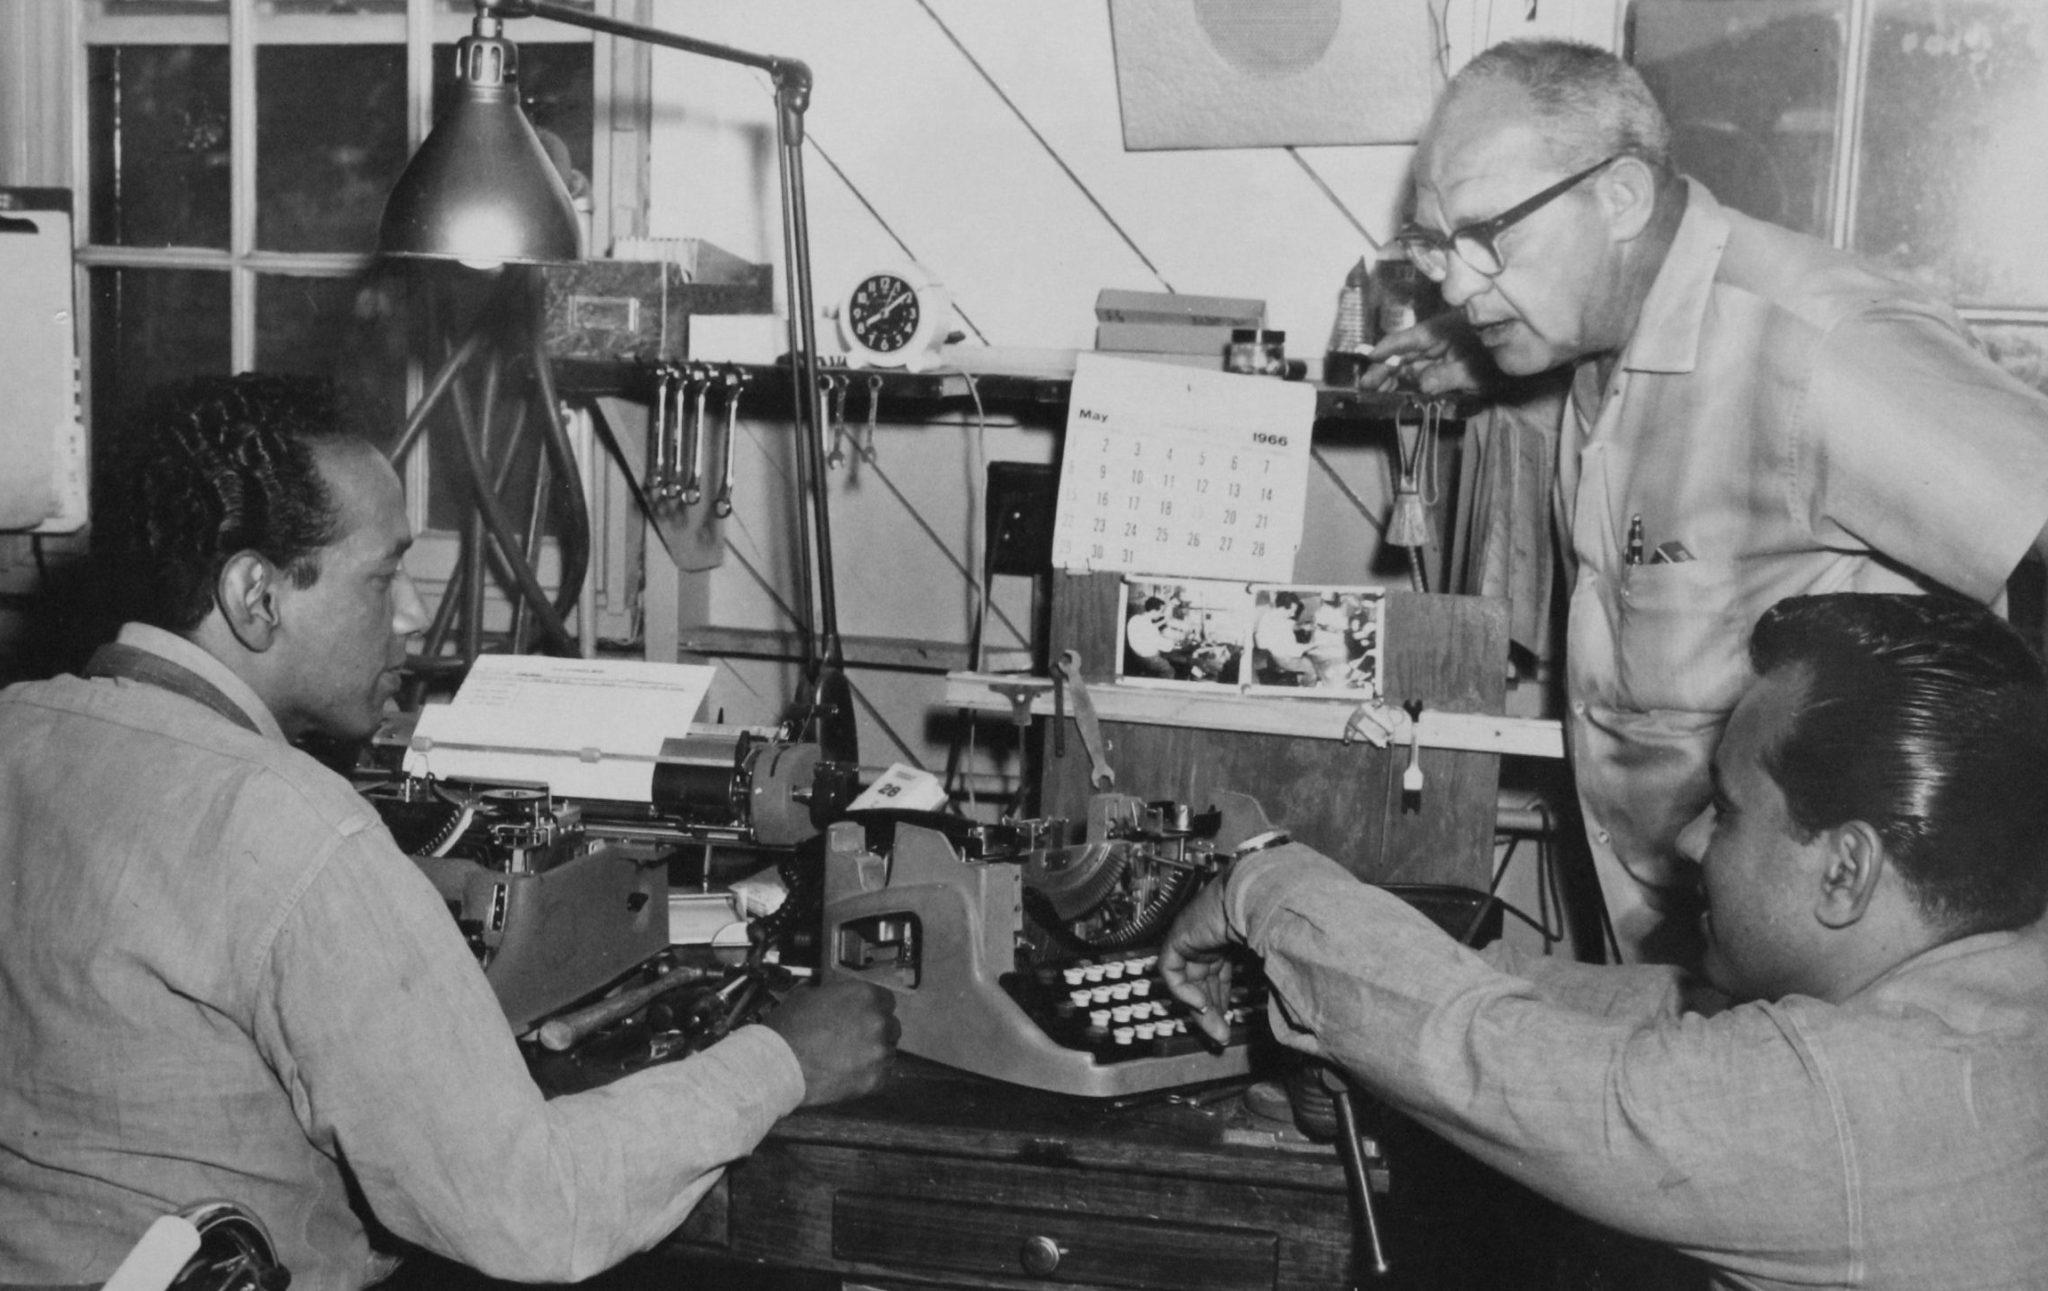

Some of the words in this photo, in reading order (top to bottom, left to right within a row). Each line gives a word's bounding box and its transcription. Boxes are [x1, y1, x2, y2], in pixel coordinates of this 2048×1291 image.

[868, 281, 876, 292] 11
[880, 277, 890, 288] 12
[857, 292, 867, 303] 10
[906, 292, 912, 303] 2
[853, 308, 861, 319] 9
[909, 308, 916, 319] 3
[857, 322, 865, 334] 8
[904, 322, 912, 333] 4
[868, 335, 876, 346] 7
[881, 339, 889, 350] 6
[896, 335, 902, 347] 5
[1080, 409, 1108, 422] May
[1254, 433, 1287, 446] 1966
[1102, 438, 1109, 452] 2
[1134, 443, 1140, 456] 3
[1167, 448, 1172, 460] 4
[1199, 452, 1205, 466] 5
[1231, 456, 1238, 470] 6
[1264, 460, 1270, 473] 7
[1100, 465, 1106, 479] 9
[1132, 470, 1143, 484] 10
[1164, 474, 1175, 487] 11
[1197, 479, 1209, 493] 12
[1229, 483, 1240, 498] 13
[1262, 488, 1272, 500] 14
[1098, 492, 1108, 506] 16
[1129, 496, 1140, 510] 17
[1161, 501, 1171, 515] 18
[1224, 509, 1236, 524] 20
[1255, 514, 1268, 528] 21
[1094, 518, 1105, 532] 23
[1125, 523, 1136, 536] 24
[1156, 527, 1168, 542] 25
[1187, 532, 1200, 547] 26
[1219, 536, 1232, 551] 27
[1252, 542, 1264, 556] 28
[1091, 544, 1103, 559] 30
[1123, 549, 1133, 562] 31
[878, 783, 901, 797] 28
